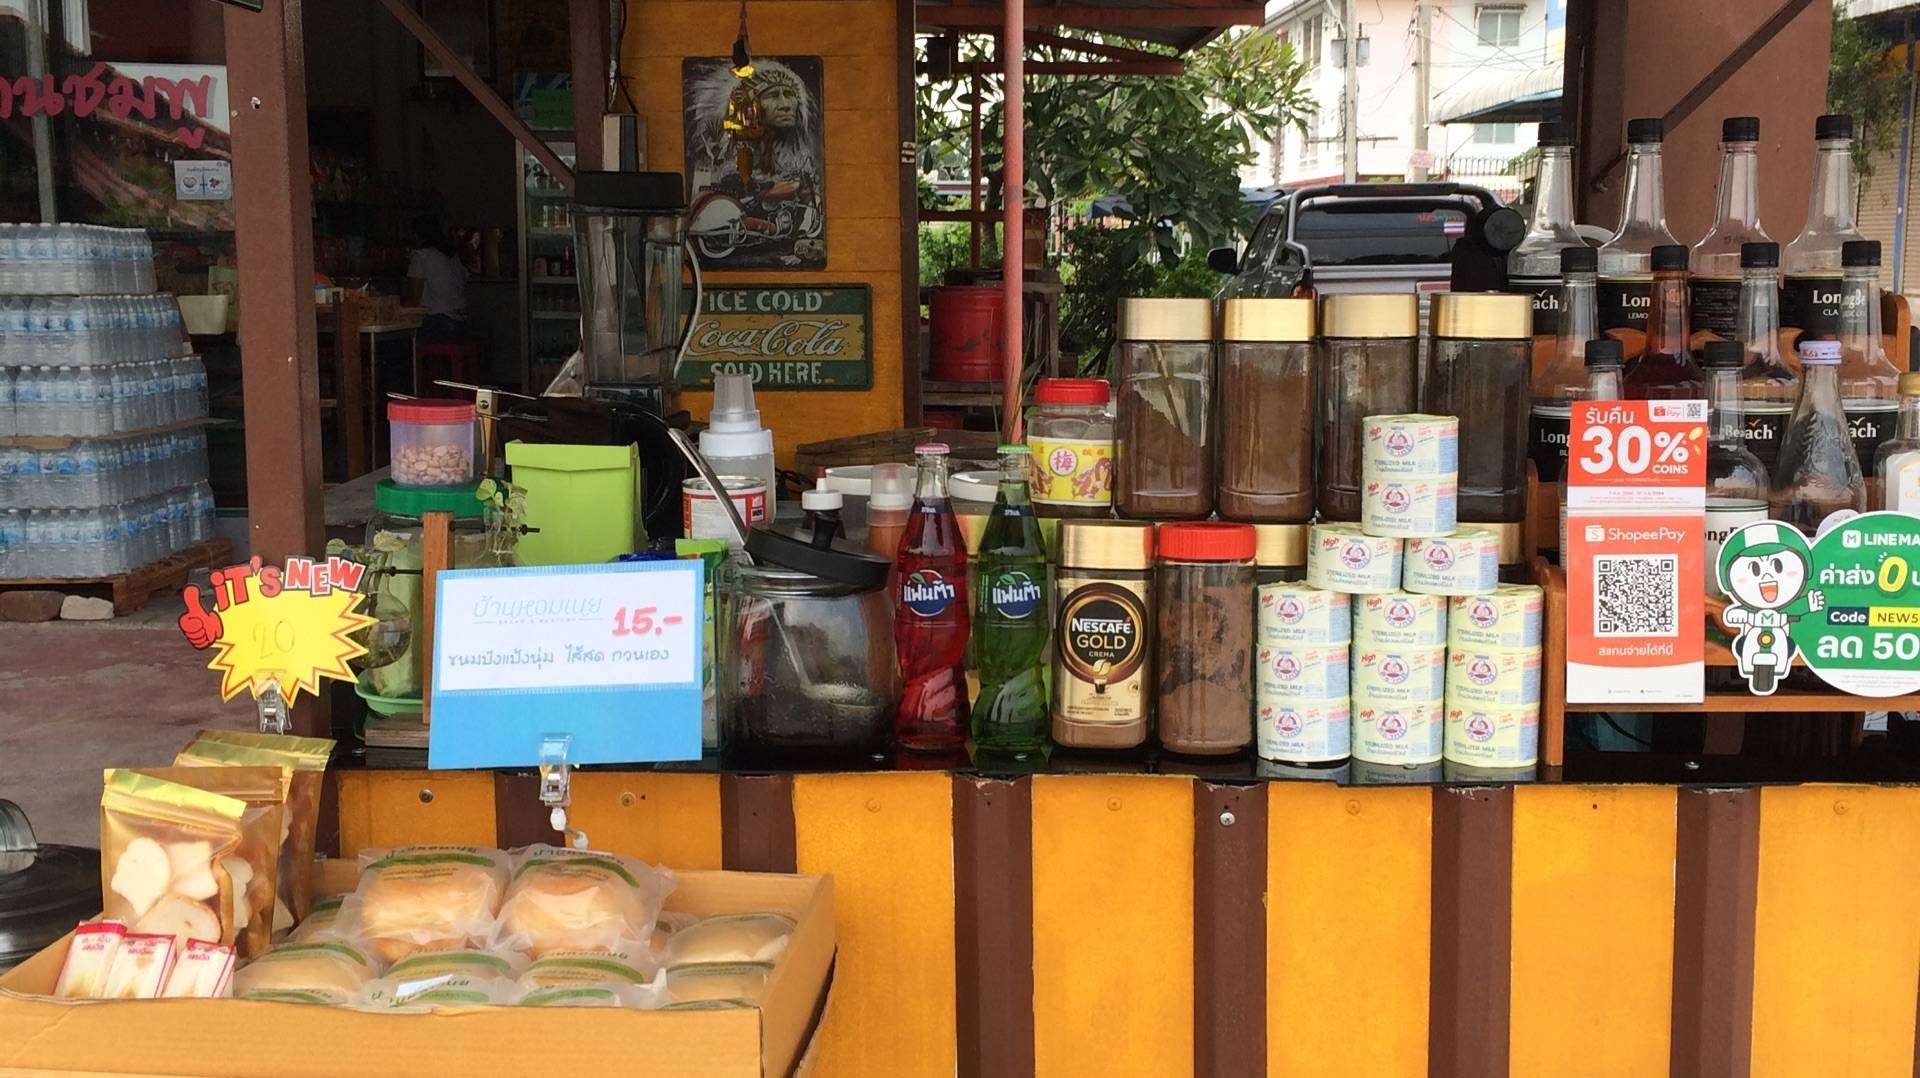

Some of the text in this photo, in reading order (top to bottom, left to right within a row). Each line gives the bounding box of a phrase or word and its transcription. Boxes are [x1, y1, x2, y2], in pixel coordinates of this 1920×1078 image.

[710, 291, 823, 312] ICE COLD
[768, 362, 823, 385] HERE
[1585, 406, 1634, 424] รับคืน
[1580, 425, 1689, 474] 30%
[1652, 464, 1689, 474] COINS
[1608, 527, 1685, 543] ShopeePay
[1864, 533, 1898, 546] LINE
[1899, 533, 1920, 546] MA
[284, 556, 366, 596] NEW
[1819, 563, 1875, 585] ค่าส่ง
[1878, 556, 1908, 592] 0
[1830, 611, 1920, 623] Code NEW5
[1076, 634, 1127, 650] GOLD
[1817, 634, 1863, 659] ลด
